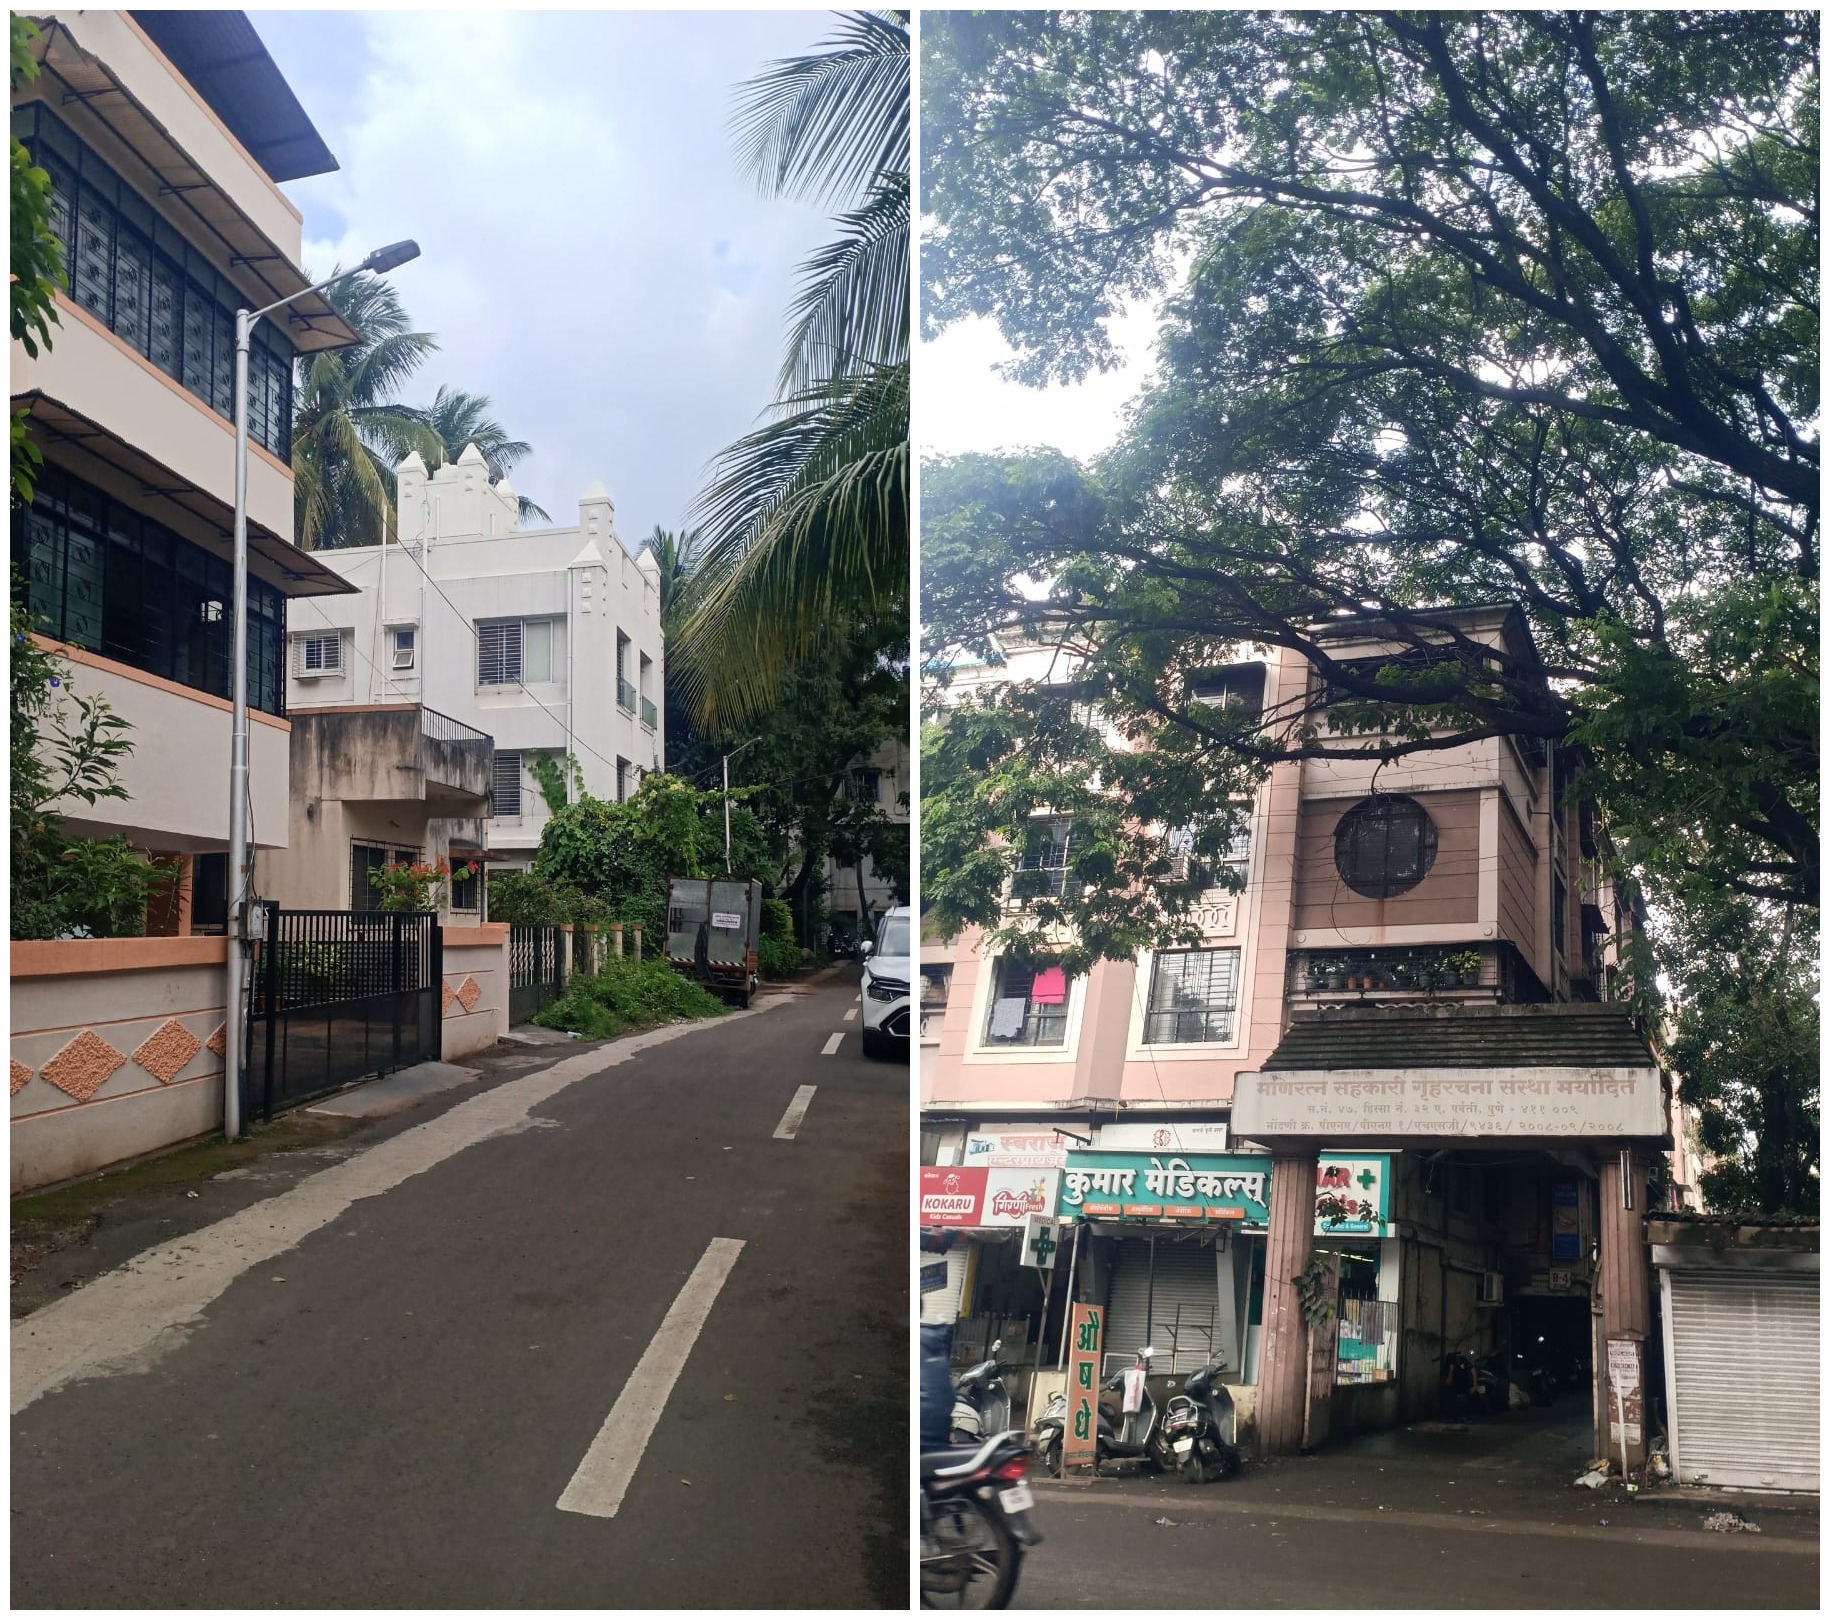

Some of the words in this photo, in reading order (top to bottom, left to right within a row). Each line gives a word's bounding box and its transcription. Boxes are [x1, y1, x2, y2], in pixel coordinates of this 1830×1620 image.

[1333, 1075, 1406, 1098] सहकारी
[1411, 1079, 1494, 1100] गृहरचना
[1499, 1075, 1551, 1096] संस्था
[1556, 1074, 1636, 1098] मर्यादित
[1062, 1167, 1136, 1205] कुमार
[1317, 1167, 1351, 1188] AR
[924, 1198, 971, 1210] KOKARU
[1034, 1217, 1056, 1226] MEDICAL
